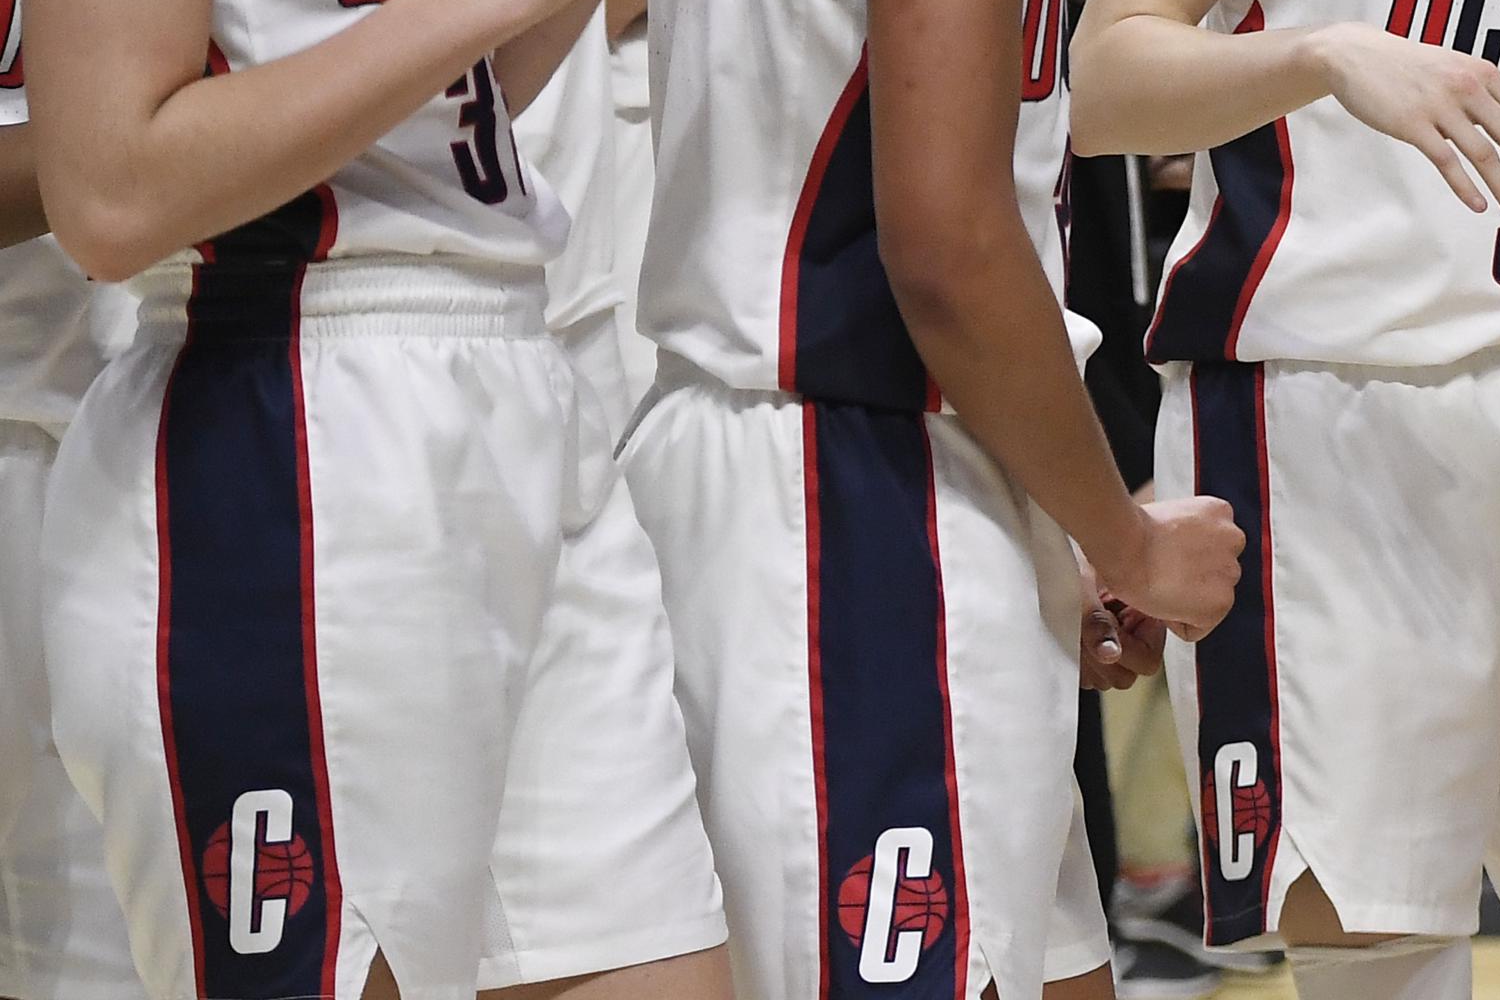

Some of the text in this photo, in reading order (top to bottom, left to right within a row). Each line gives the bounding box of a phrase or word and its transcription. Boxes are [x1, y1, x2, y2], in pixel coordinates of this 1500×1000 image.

[229, 789, 293, 954] C
[1214, 741, 1258, 882] C
[858, 827, 934, 984] C
